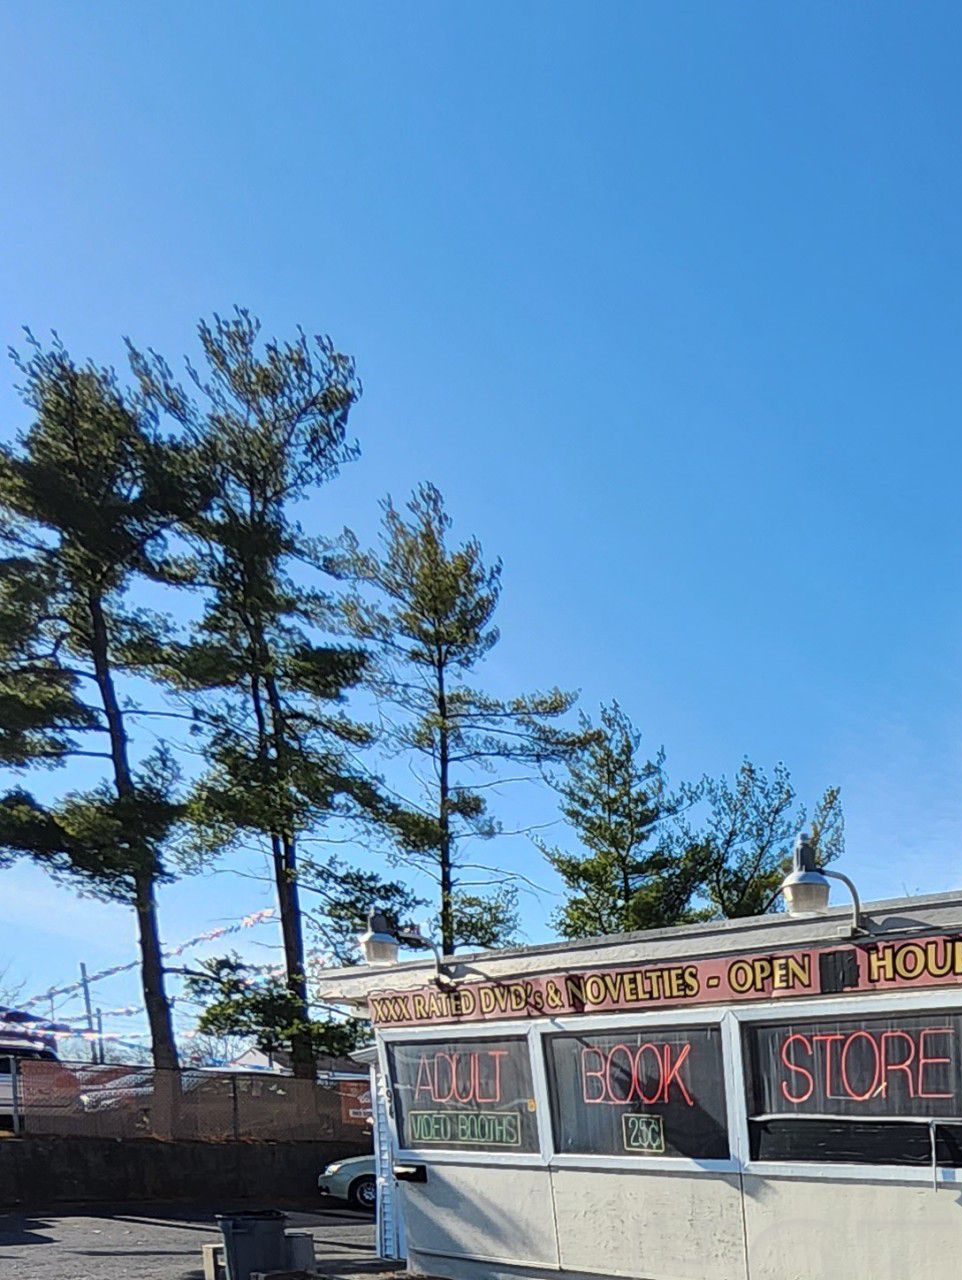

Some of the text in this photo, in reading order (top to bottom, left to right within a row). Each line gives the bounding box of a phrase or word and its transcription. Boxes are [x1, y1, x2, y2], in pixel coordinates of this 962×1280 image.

[374, 995, 412, 1023] XXX
[413, 987, 475, 1019] RATED
[546, 980, 564, 1008] &
[565, 964, 700, 1006] NOVELTIES
[727, 953, 812, 993] OPEN
[414, 1028, 955, 1106] ADULT BOOK STORE
[411, 1113, 518, 1143] VIDEO BOOTHS
